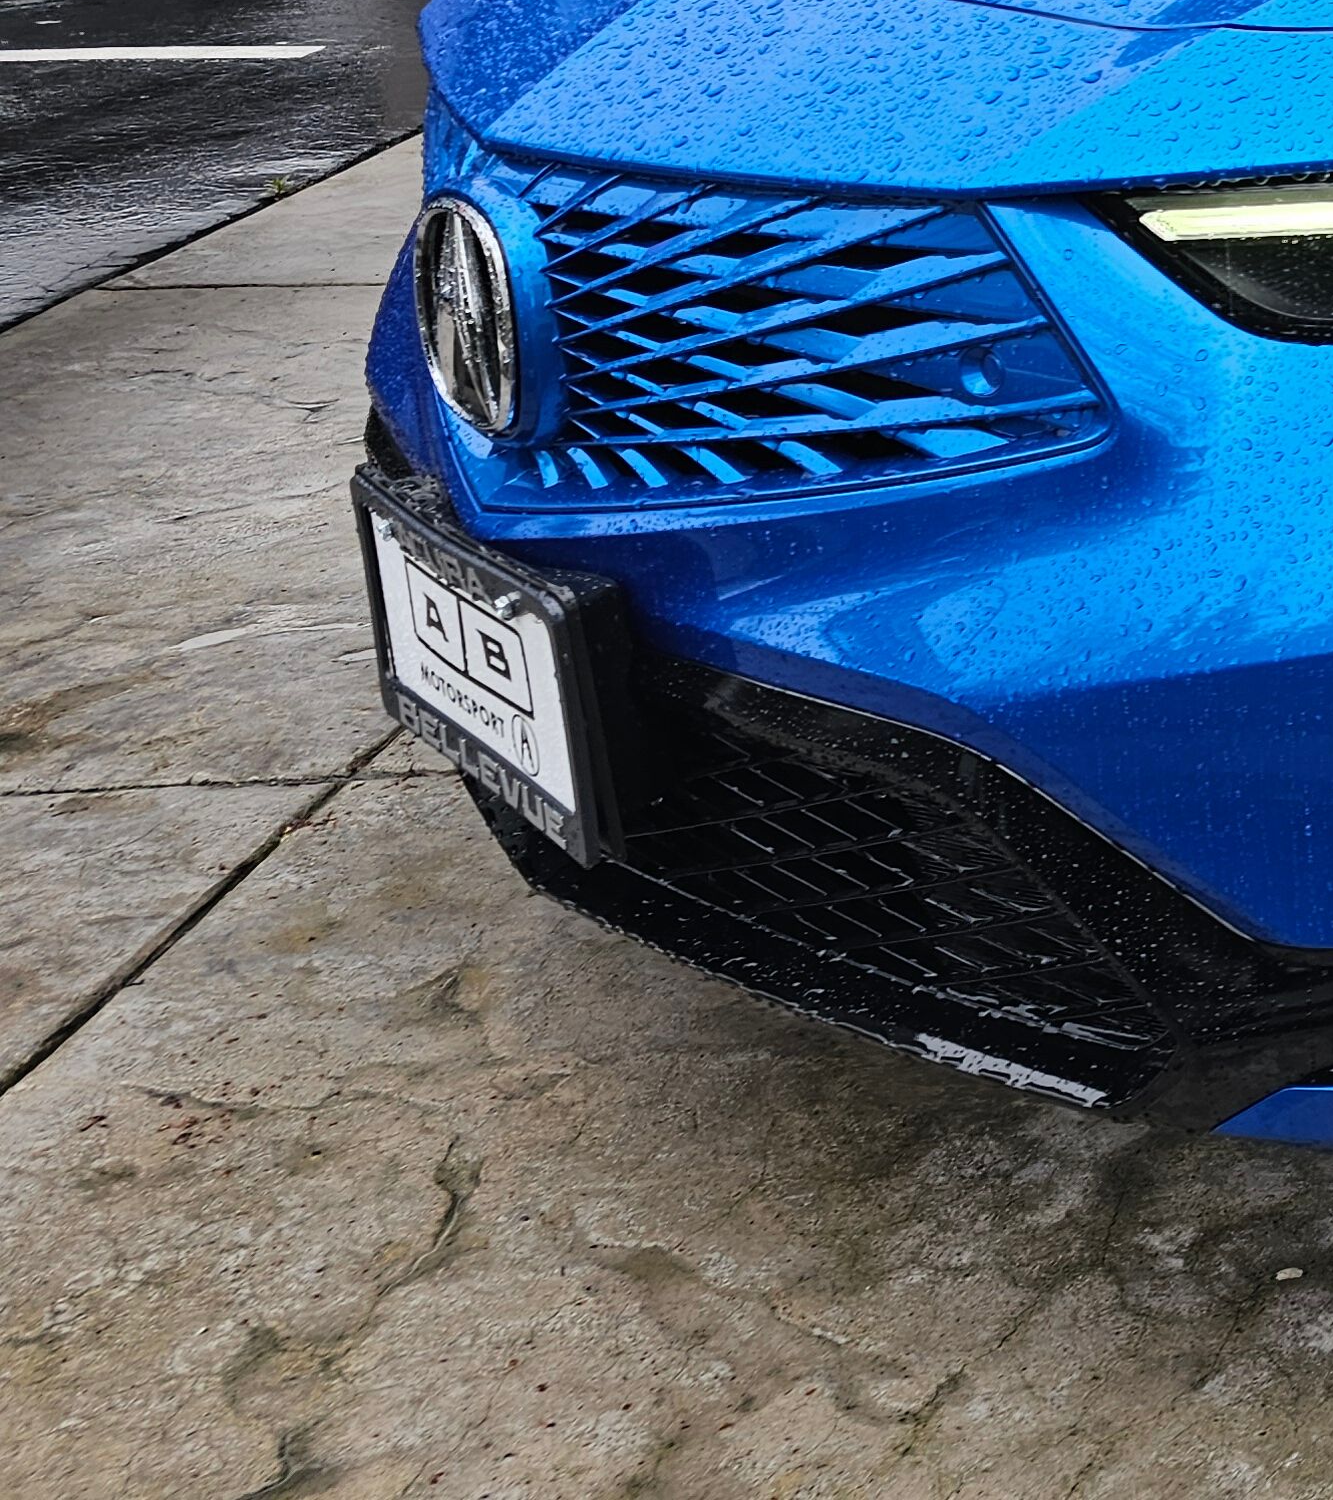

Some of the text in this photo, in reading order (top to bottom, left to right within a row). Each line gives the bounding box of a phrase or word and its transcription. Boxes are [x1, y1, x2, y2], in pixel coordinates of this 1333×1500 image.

[423, 593, 512, 681] A B
[420, 661, 505, 739] MOTORSPORT
[398, 697, 568, 851] BELLEVUE
